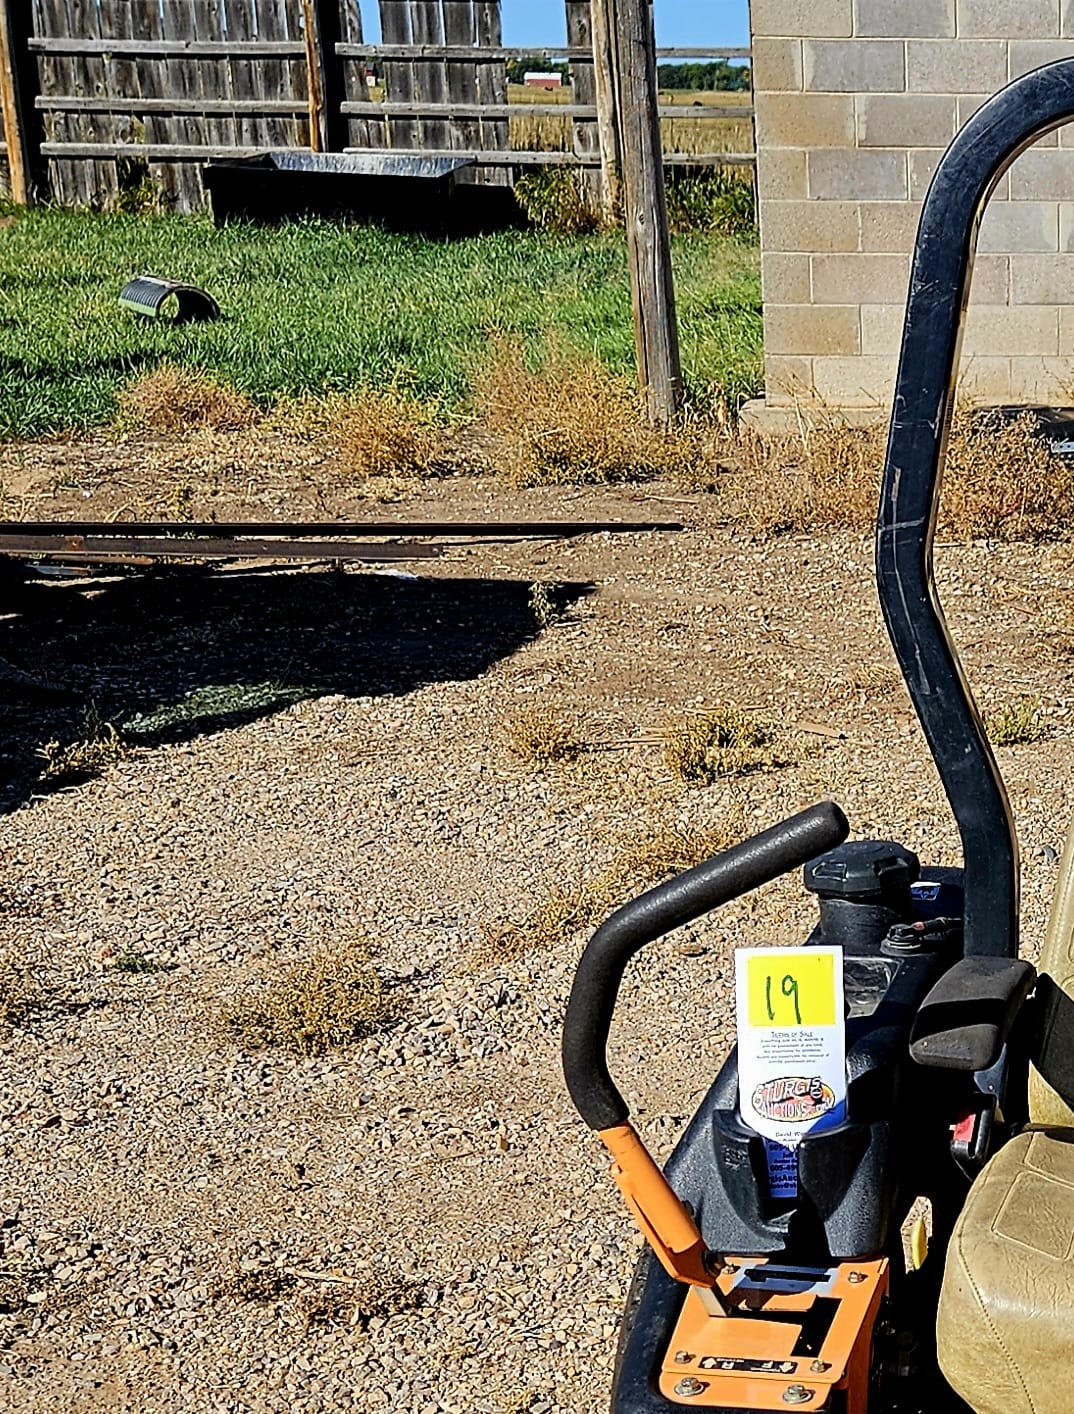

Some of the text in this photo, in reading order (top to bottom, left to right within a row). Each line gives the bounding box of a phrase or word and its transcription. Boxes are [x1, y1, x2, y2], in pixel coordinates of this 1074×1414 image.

[765, 974, 802, 1025] 19
[754, 1076, 822, 1106] STURGIS
[721, 1360, 774, 1369] R F
